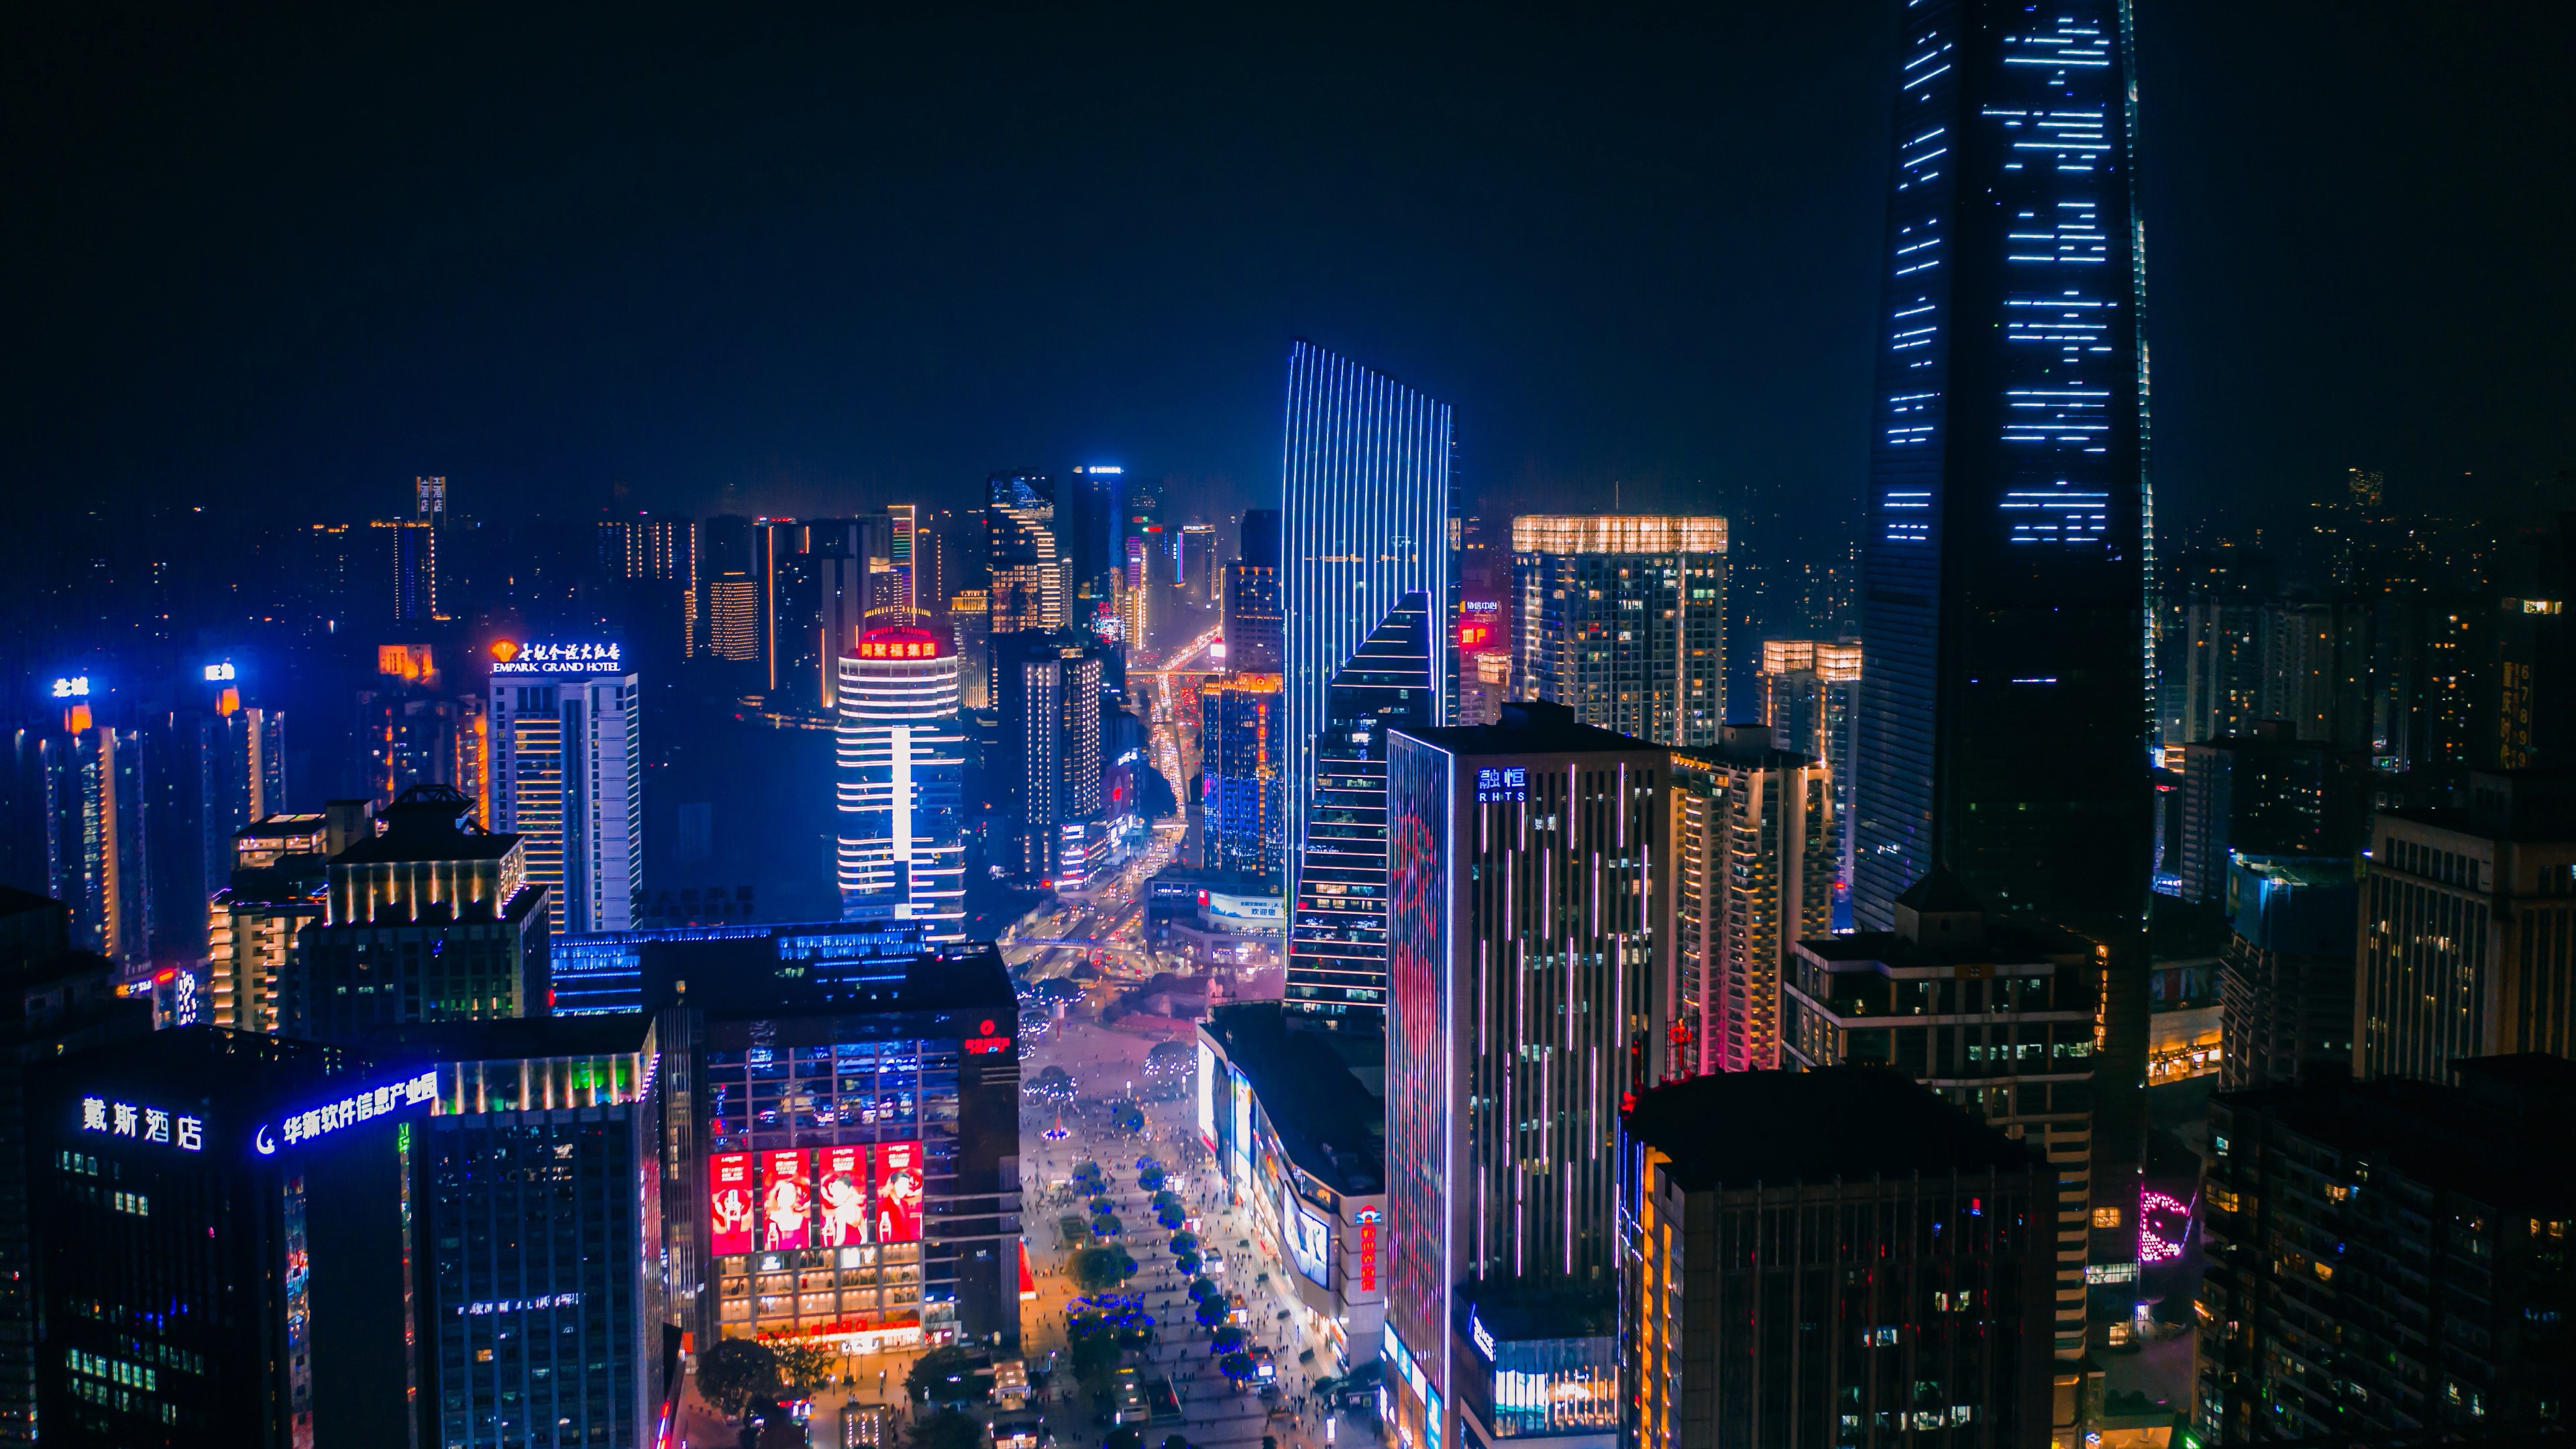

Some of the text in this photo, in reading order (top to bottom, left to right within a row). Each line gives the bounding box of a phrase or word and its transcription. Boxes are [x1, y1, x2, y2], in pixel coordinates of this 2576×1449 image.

[1467, 601, 1497, 610] 协信中心
[1462, 629, 1486, 643] 地产
[494, 661, 621, 672] EMPARK GRAND HOTEL
[1479, 768, 1525, 789] 融恒
[1480, 792, 1525, 801] RHTS
[284, 1071, 437, 1144] 华新软件信息产业园
[83, 1097, 202, 1150] 戴斯酒店
